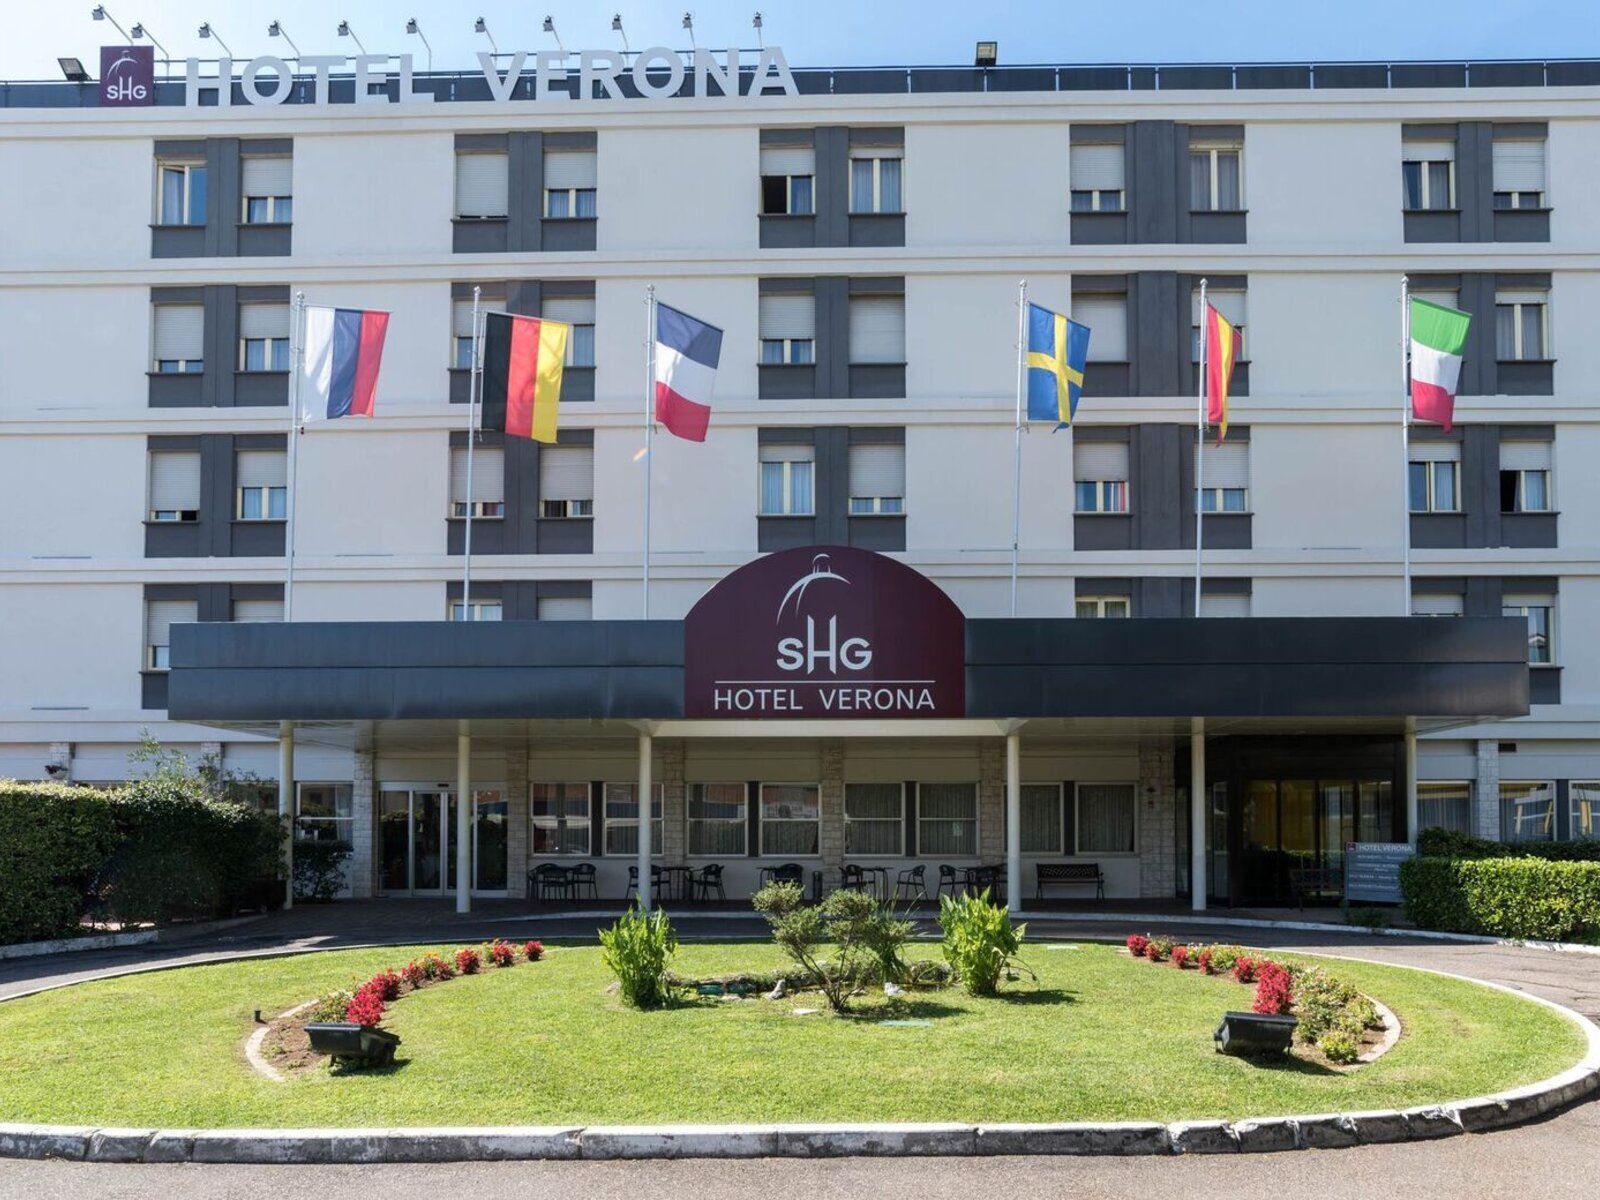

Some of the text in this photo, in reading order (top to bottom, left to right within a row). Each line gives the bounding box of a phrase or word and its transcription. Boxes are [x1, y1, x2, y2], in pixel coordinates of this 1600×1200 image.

[186, 46, 800, 106] HOTEL VERONA
[713, 688, 936, 711] HOTEL VERONA
